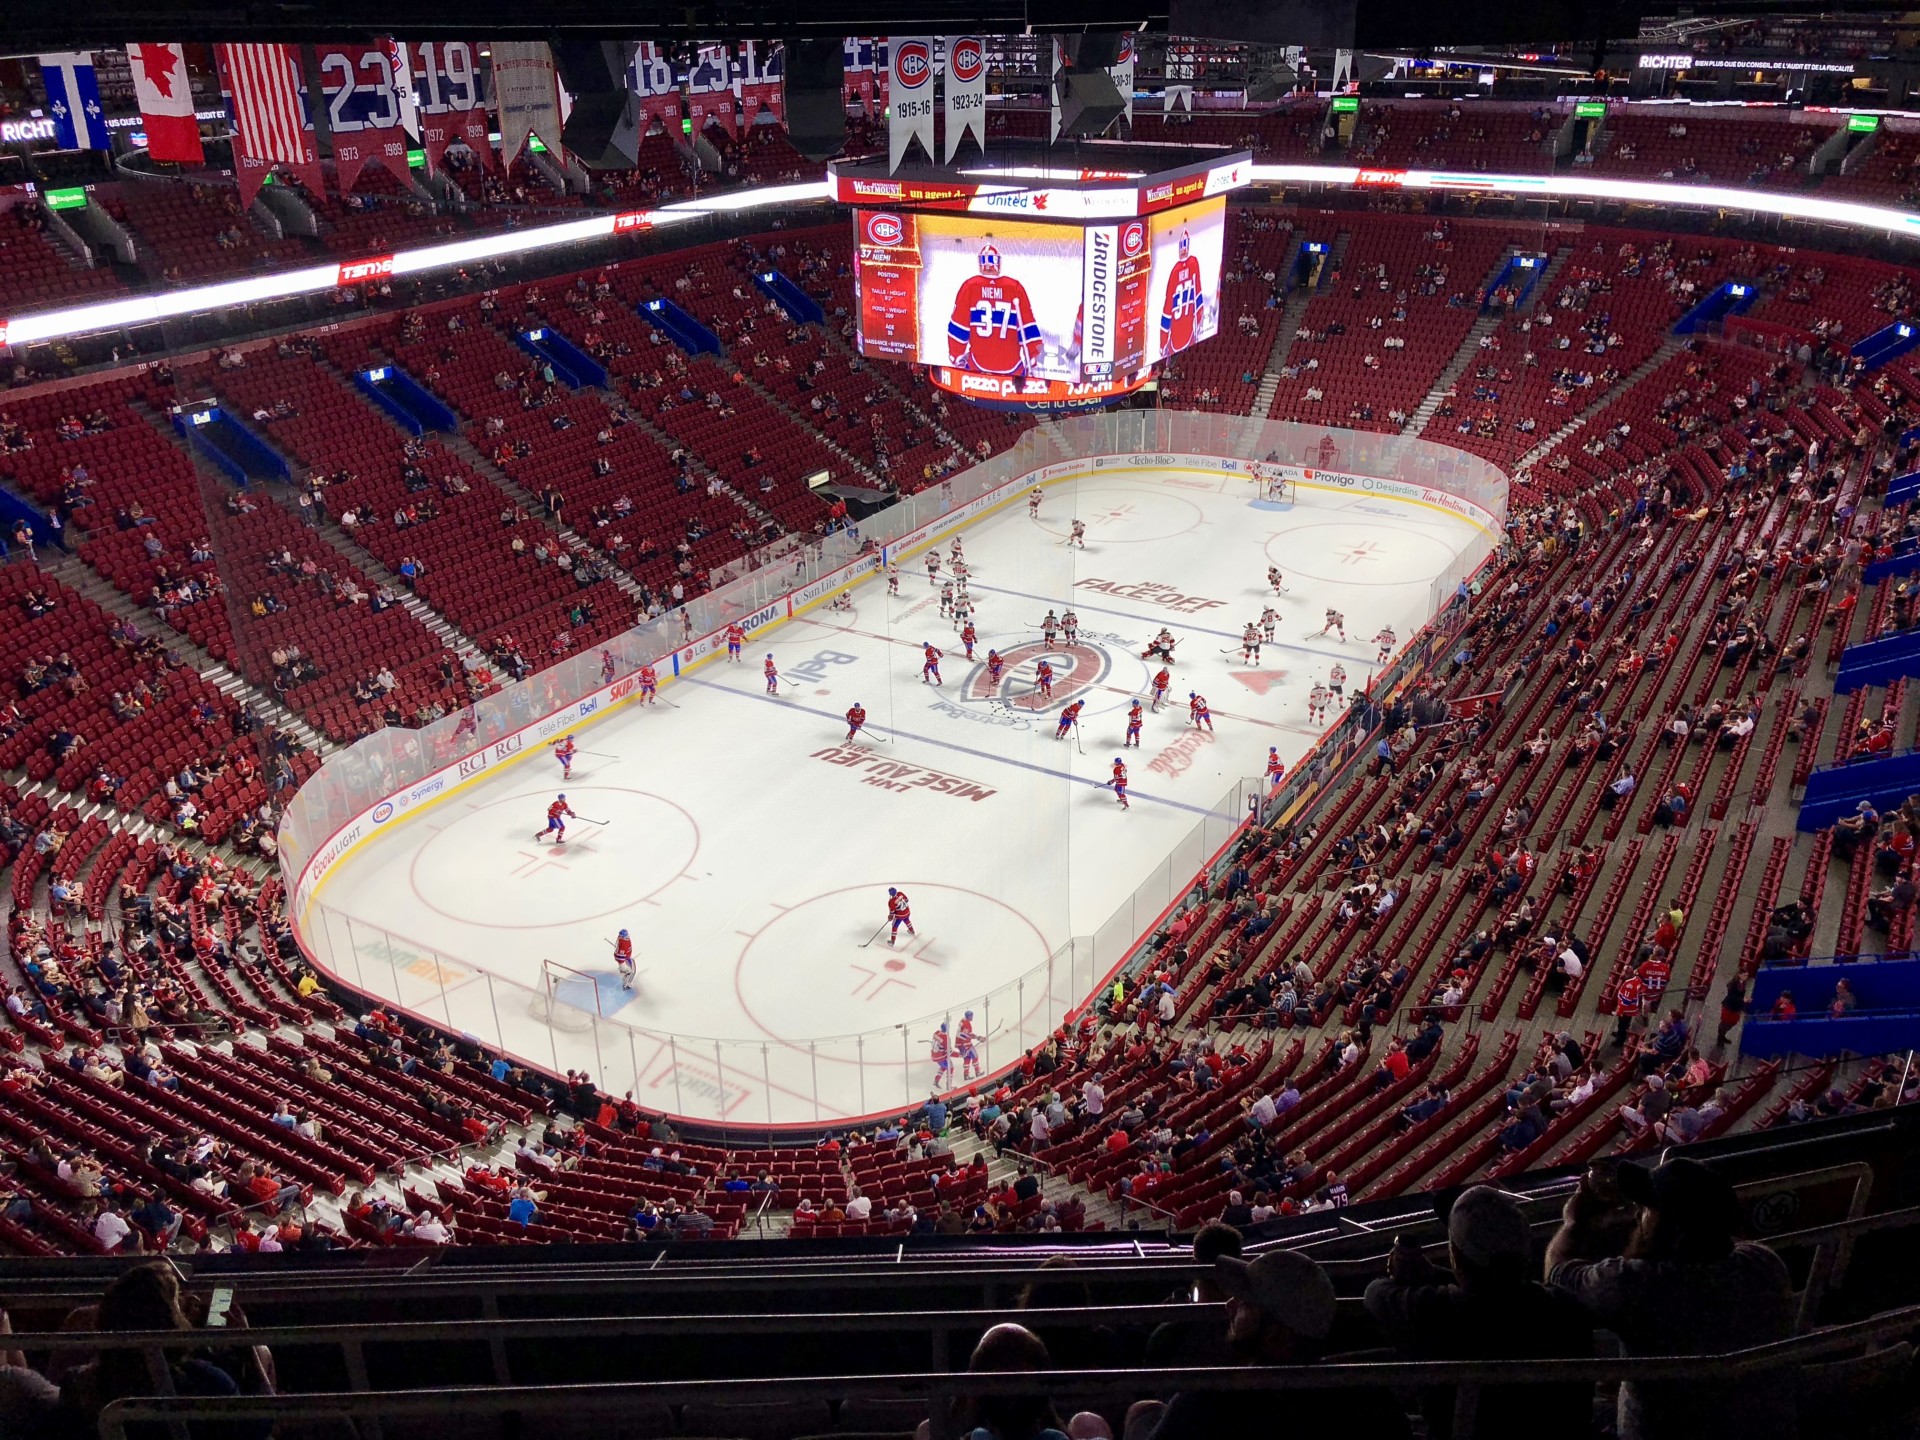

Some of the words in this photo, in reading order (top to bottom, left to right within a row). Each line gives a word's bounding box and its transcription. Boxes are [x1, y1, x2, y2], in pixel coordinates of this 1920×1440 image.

[1639, 55, 1693, 68] RICHTER
[418, 41, 477, 115] 19
[321, 51, 400, 133] 23
[897, 100, 931, 118] 1915-16
[952, 93, 983, 110] 1923-24
[2, 120, 55, 140] RICHT
[910, 190, 922, 198] un
[925, 190, 952, 199] agent
[987, 195, 1028, 208] United
[861, 249, 871, 258] 37
[1310, 243, 1321, 252] Bell
[873, 253, 891, 261] NIEMI
[1520, 258, 1534, 267] Bell
[878, 271, 899, 279] POSITION
[982, 286, 1002, 299] NIEMI
[1091, 231, 1110, 358] BRIDGESTONE
[1732, 285, 1745, 295] Bell
[650, 301, 660, 310] Bell
[1174, 279, 1192, 319] 37
[976, 300, 1011, 338] 37
[530, 330, 541, 340] Bell
[1900, 325, 1910, 337] Bell
[370, 369, 384, 381] Bell
[962, 375, 999, 392] pizza
[192, 411, 210, 425] Bell
[1134, 456, 1171, 465] Techo-Bloc
[1201, 458, 1217, 468] Fibe
[1221, 460, 1237, 470] Bell
[1027, 473, 1036, 485] Bell
[1314, 471, 1355, 486] Provigo
[1376, 482, 1418, 496] Desjardins
[971, 500, 984, 510] THE
[1421, 488, 1437, 503] Tim
[1438, 494, 1467, 514] Hortons
[803, 588, 820, 601] Sun
[821, 577, 837, 592] Life
[1072, 578, 1229, 610] FACE-OFF
[1138, 581, 1178, 592] NHL
[1166, 605, 1199, 614] 2018
[741, 605, 780, 633] RONA
[1066, 618, 1075, 626] 43
[695, 643, 706, 656] LG
[782, 649, 859, 683] Bell
[609, 678, 634, 703] SKIP
[538, 720, 556, 738] Télé
[557, 712, 576, 730] Fibe
[579, 698, 598, 717] Bell
[927, 701, 1031, 731] CentreBell
[495, 733, 523, 758] RCI
[458, 750, 488, 777] RCI
[808, 747, 878, 767] JEU
[864, 762, 921, 779] AU
[411, 778, 444, 800] Synergy
[860, 776, 911, 793] LNH
[906, 773, 998, 802] MISE
[312, 848, 336, 880] Coors
[335, 826, 362, 854] LIGHT
[1648, 976, 1661, 989] 11
[1333, 1193, 1349, 1209] 79
